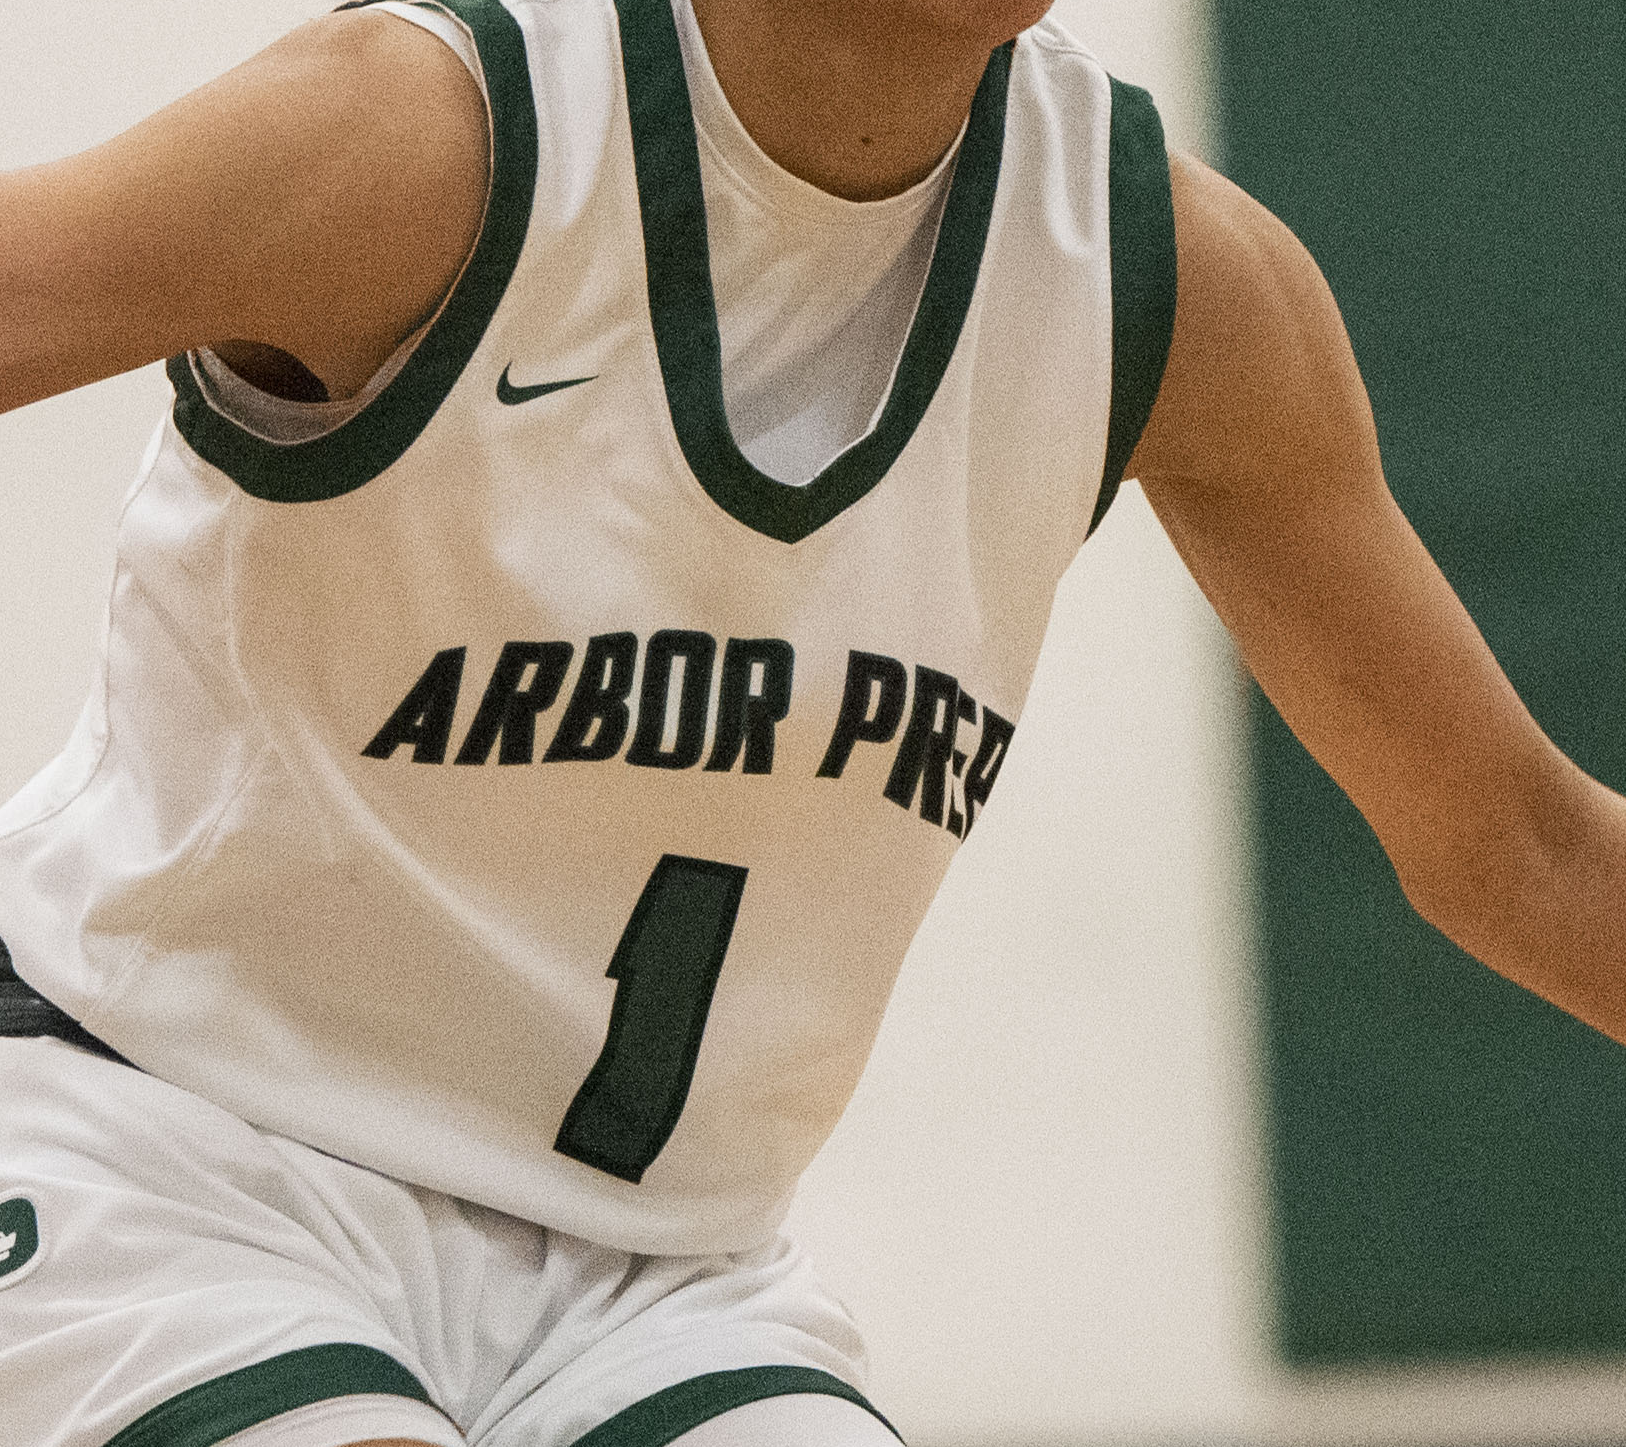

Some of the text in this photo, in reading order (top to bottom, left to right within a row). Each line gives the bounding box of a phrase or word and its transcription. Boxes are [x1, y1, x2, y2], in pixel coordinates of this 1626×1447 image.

[361, 630, 1016, 844] ARBOR PREP
[553, 853, 749, 1185] 1
